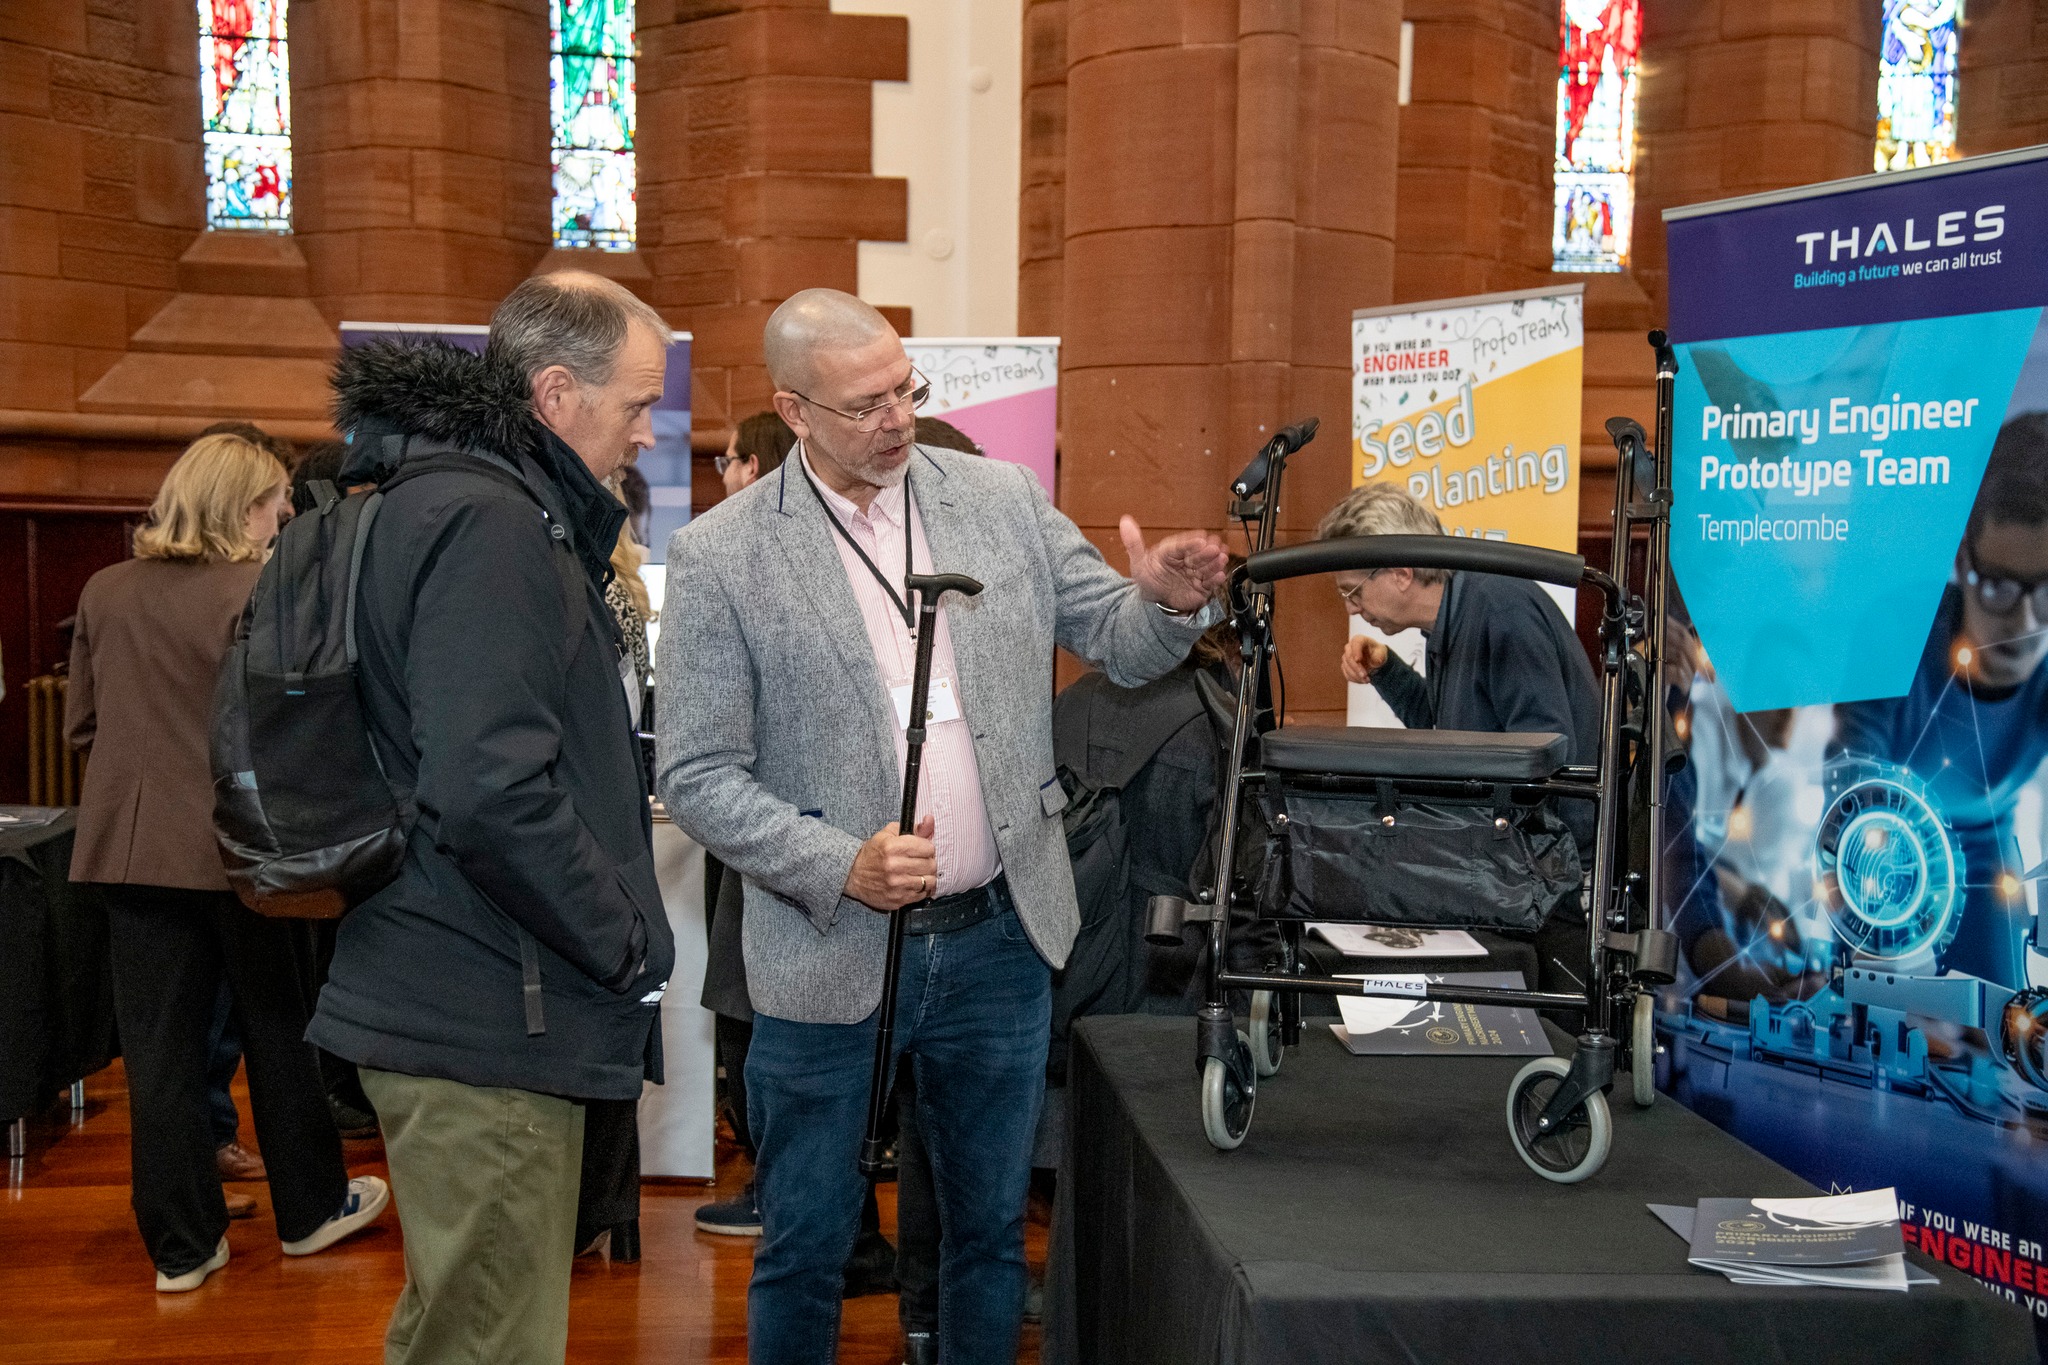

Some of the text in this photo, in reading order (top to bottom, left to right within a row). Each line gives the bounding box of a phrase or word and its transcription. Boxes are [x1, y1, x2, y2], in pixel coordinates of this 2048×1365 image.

[1795, 205, 2006, 265] THALES
[1793, 249, 2002, 289] Building a future we can all trust
[1363, 348, 1449, 373] ENGINEER
[1374, 342, 1390, 352] YOU
[1395, 339, 1417, 351] WERE
[1389, 373, 1418, 385] WOULD
[1422, 371, 1439, 382] YOU
[1442, 368, 1461, 381] DO?
[1360, 378, 1475, 478] Seed
[1702, 391, 1979, 445] Primary Engineer
[1407, 443, 1568, 510] Planting
[1700, 449, 1950, 496] Prototype Team
[1698, 513, 1849, 547] Templecombe
[1364, 980, 1424, 991] THALES
[1715, 1230, 1857, 1239] PRIMARY ENGINEER
[1810, 1235, 1857, 1243] MEDAL
[1900, 1200, 2042, 1262] IF YOU WERE an
